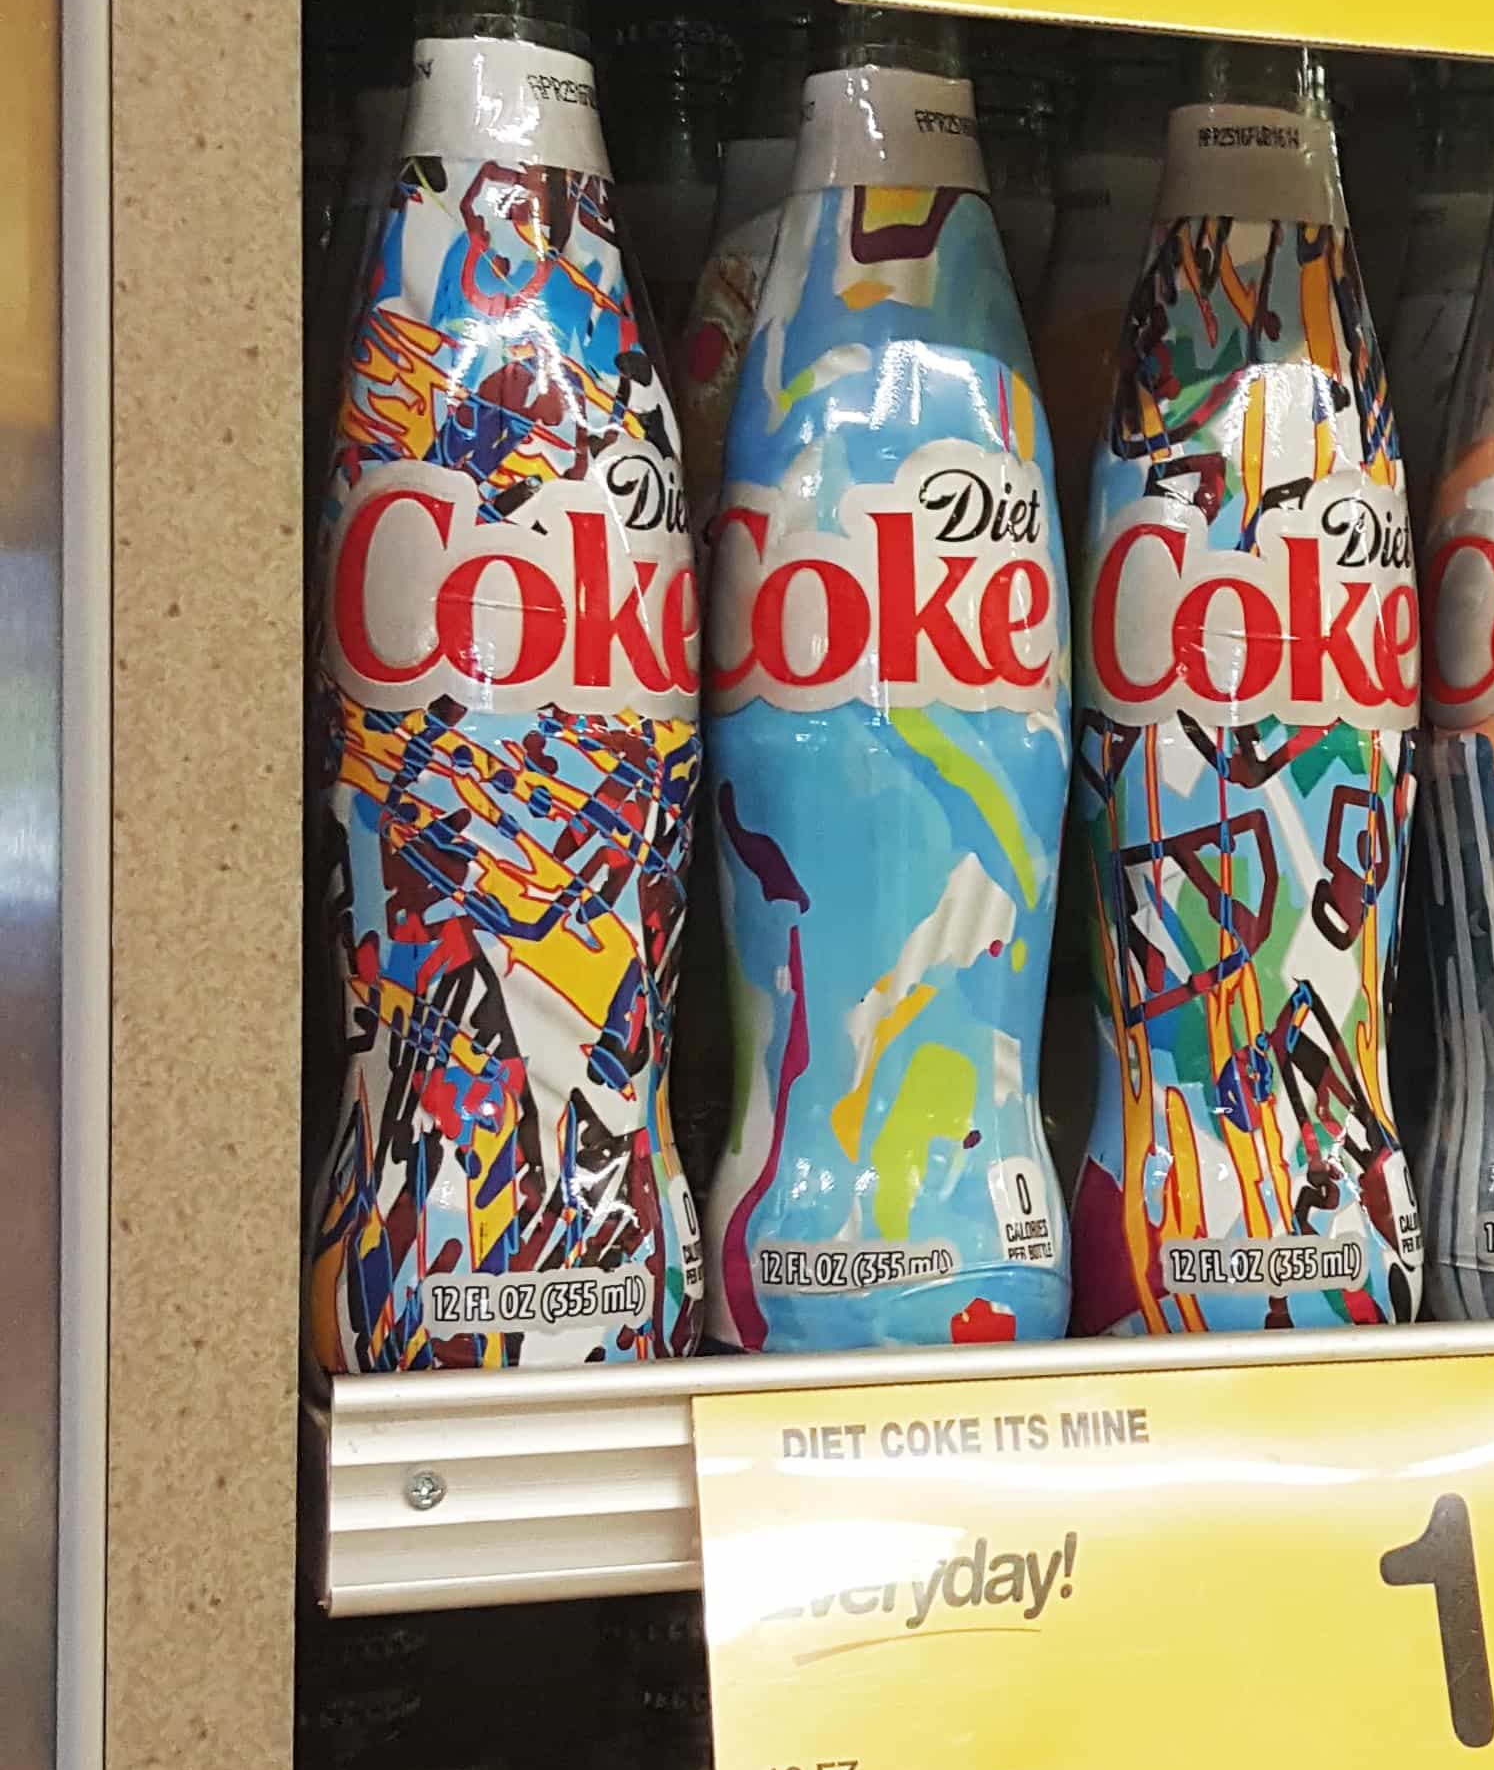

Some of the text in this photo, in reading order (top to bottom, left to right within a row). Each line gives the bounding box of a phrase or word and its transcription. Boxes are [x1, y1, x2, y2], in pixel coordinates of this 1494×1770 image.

[919, 467, 1041, 545] Diet
[704, 507, 1053, 691] Coke
[1093, 524, 1420, 709] Coke
[1016, 1173, 1032, 1215] 0
[761, 1250, 903, 1288] 12 FL OZ (355
[1170, 1242, 1362, 1283] 12 FL OZ (355 mL)
[431, 1276, 647, 1323] 12 FL OZ (355 mL)
[782, 1408, 1150, 1460] DIET COKE ITS MINE
